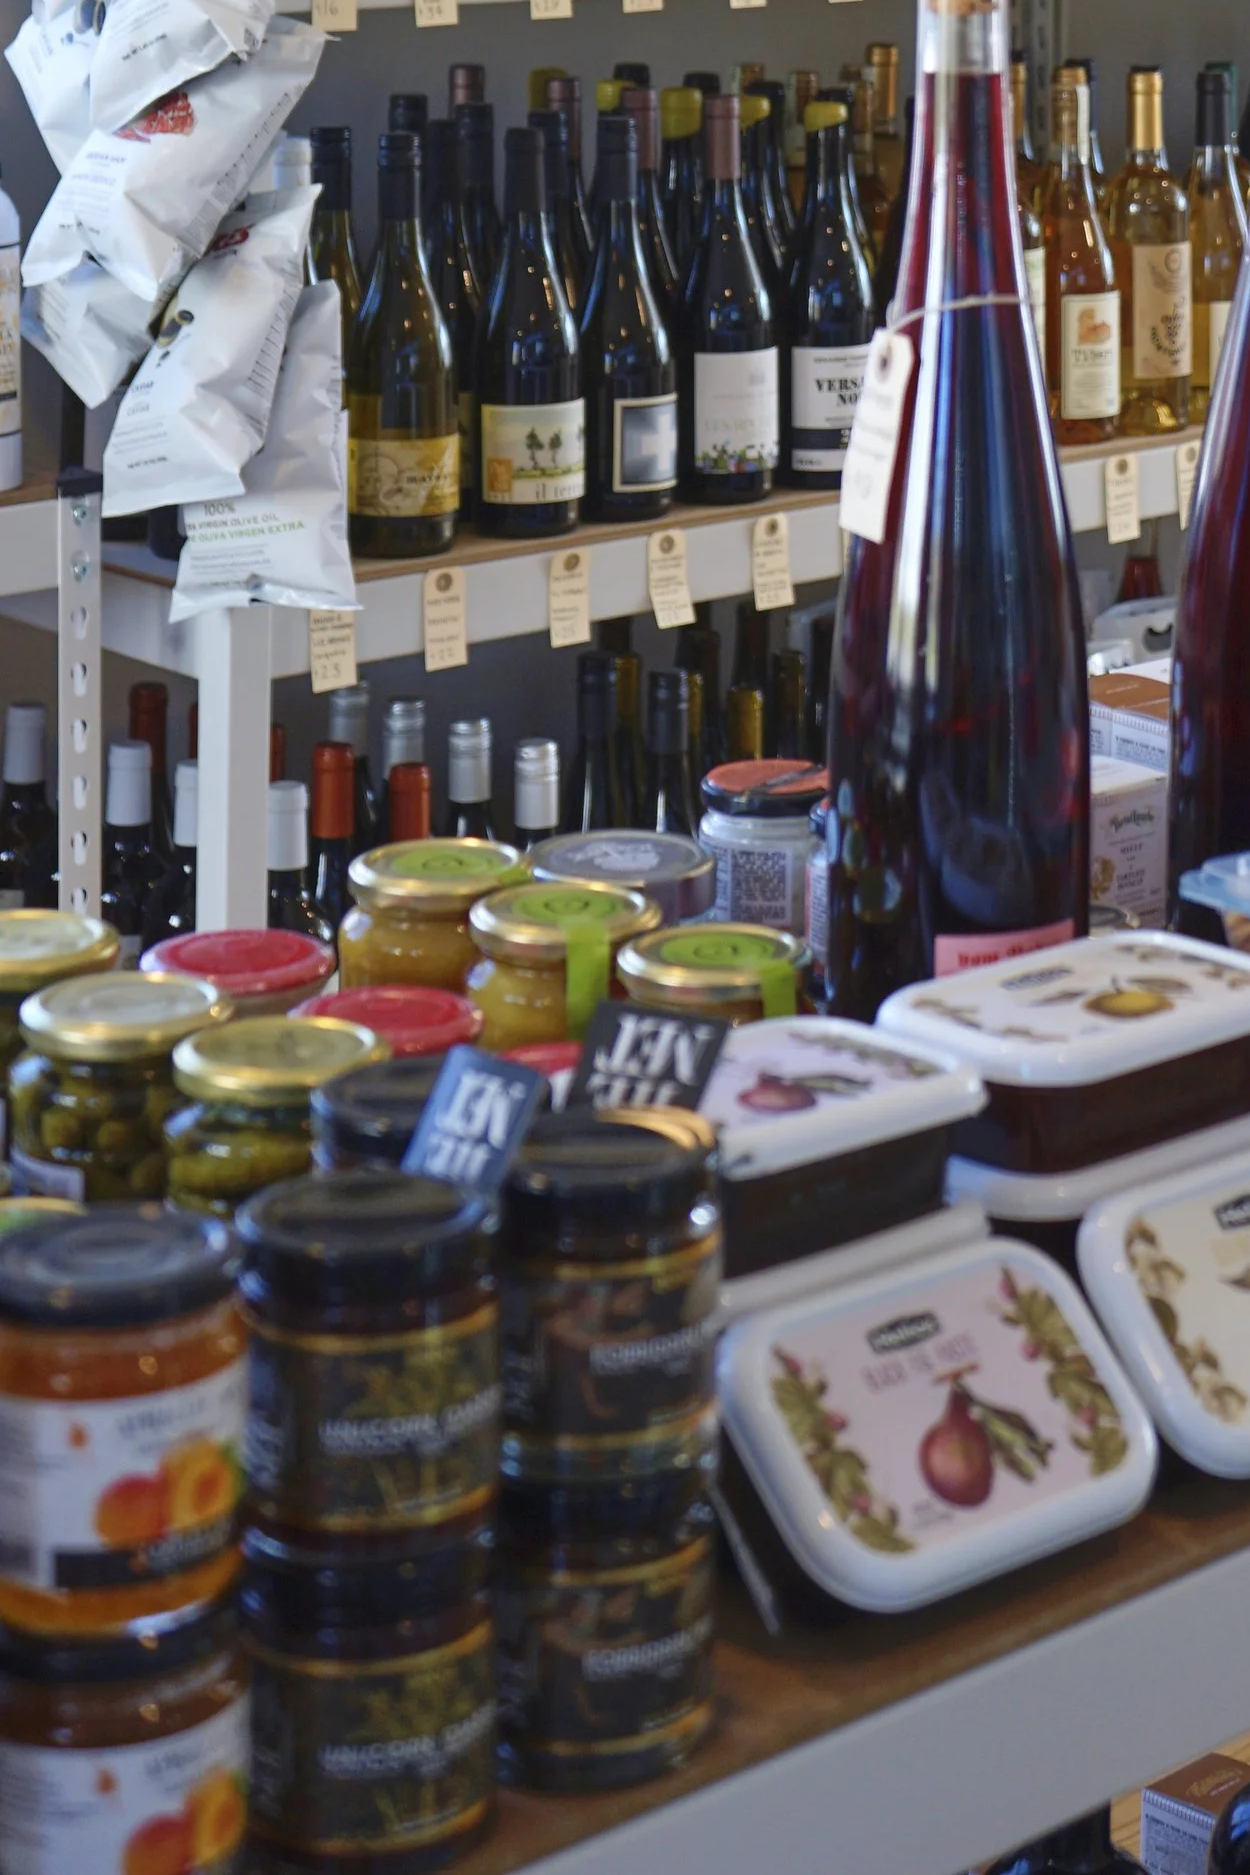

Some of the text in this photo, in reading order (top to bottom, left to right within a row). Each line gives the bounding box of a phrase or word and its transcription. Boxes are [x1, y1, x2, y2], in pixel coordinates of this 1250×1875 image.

[837, 392, 858, 408] NO
[230, 516, 260, 526] OLIVE
[262, 512, 280, 523] OIL
[268, 520, 307, 535] EXTRA
